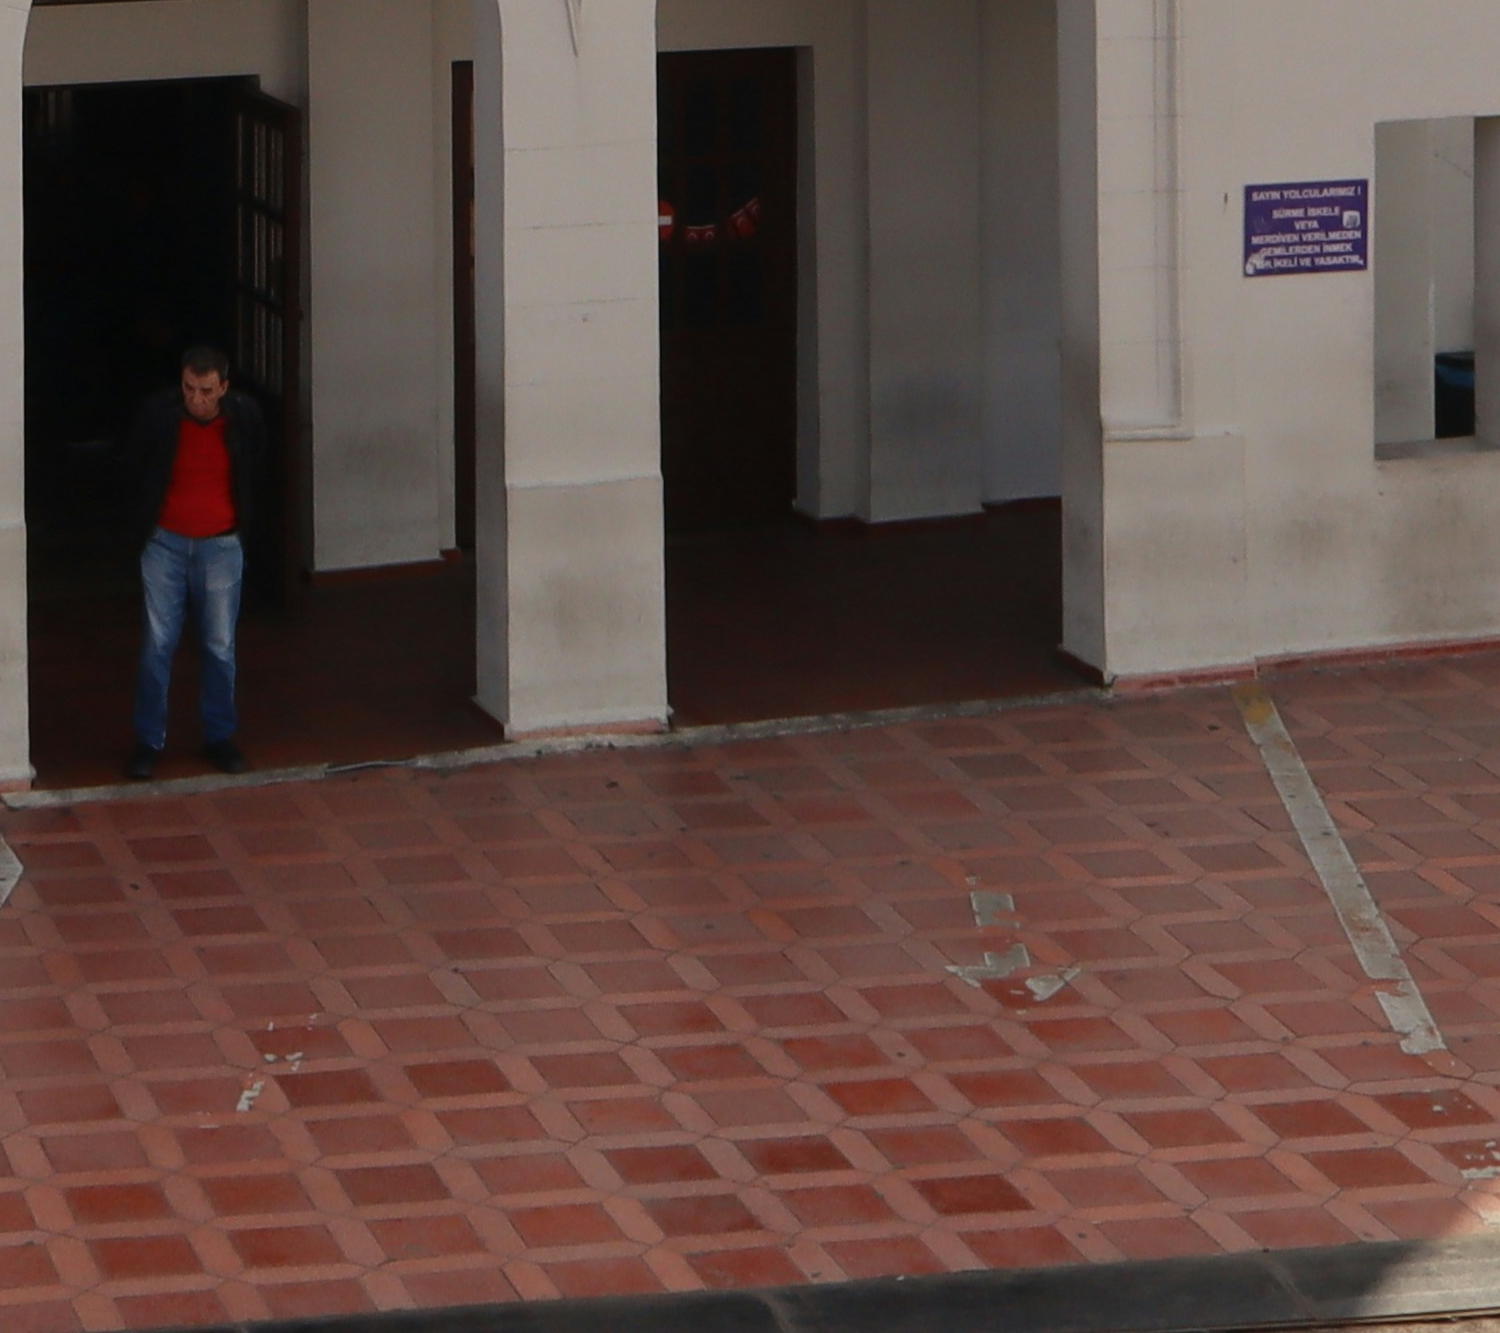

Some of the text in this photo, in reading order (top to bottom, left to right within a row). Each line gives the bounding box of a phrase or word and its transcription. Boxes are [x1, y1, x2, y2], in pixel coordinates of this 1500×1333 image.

[1252, 190, 1281, 201] SAYIN
[1282, 186, 1356, 199] YOLCULARIMIZ
[1293, 219, 1319, 230] VEYA
[1299, 257, 1311, 266] VE
